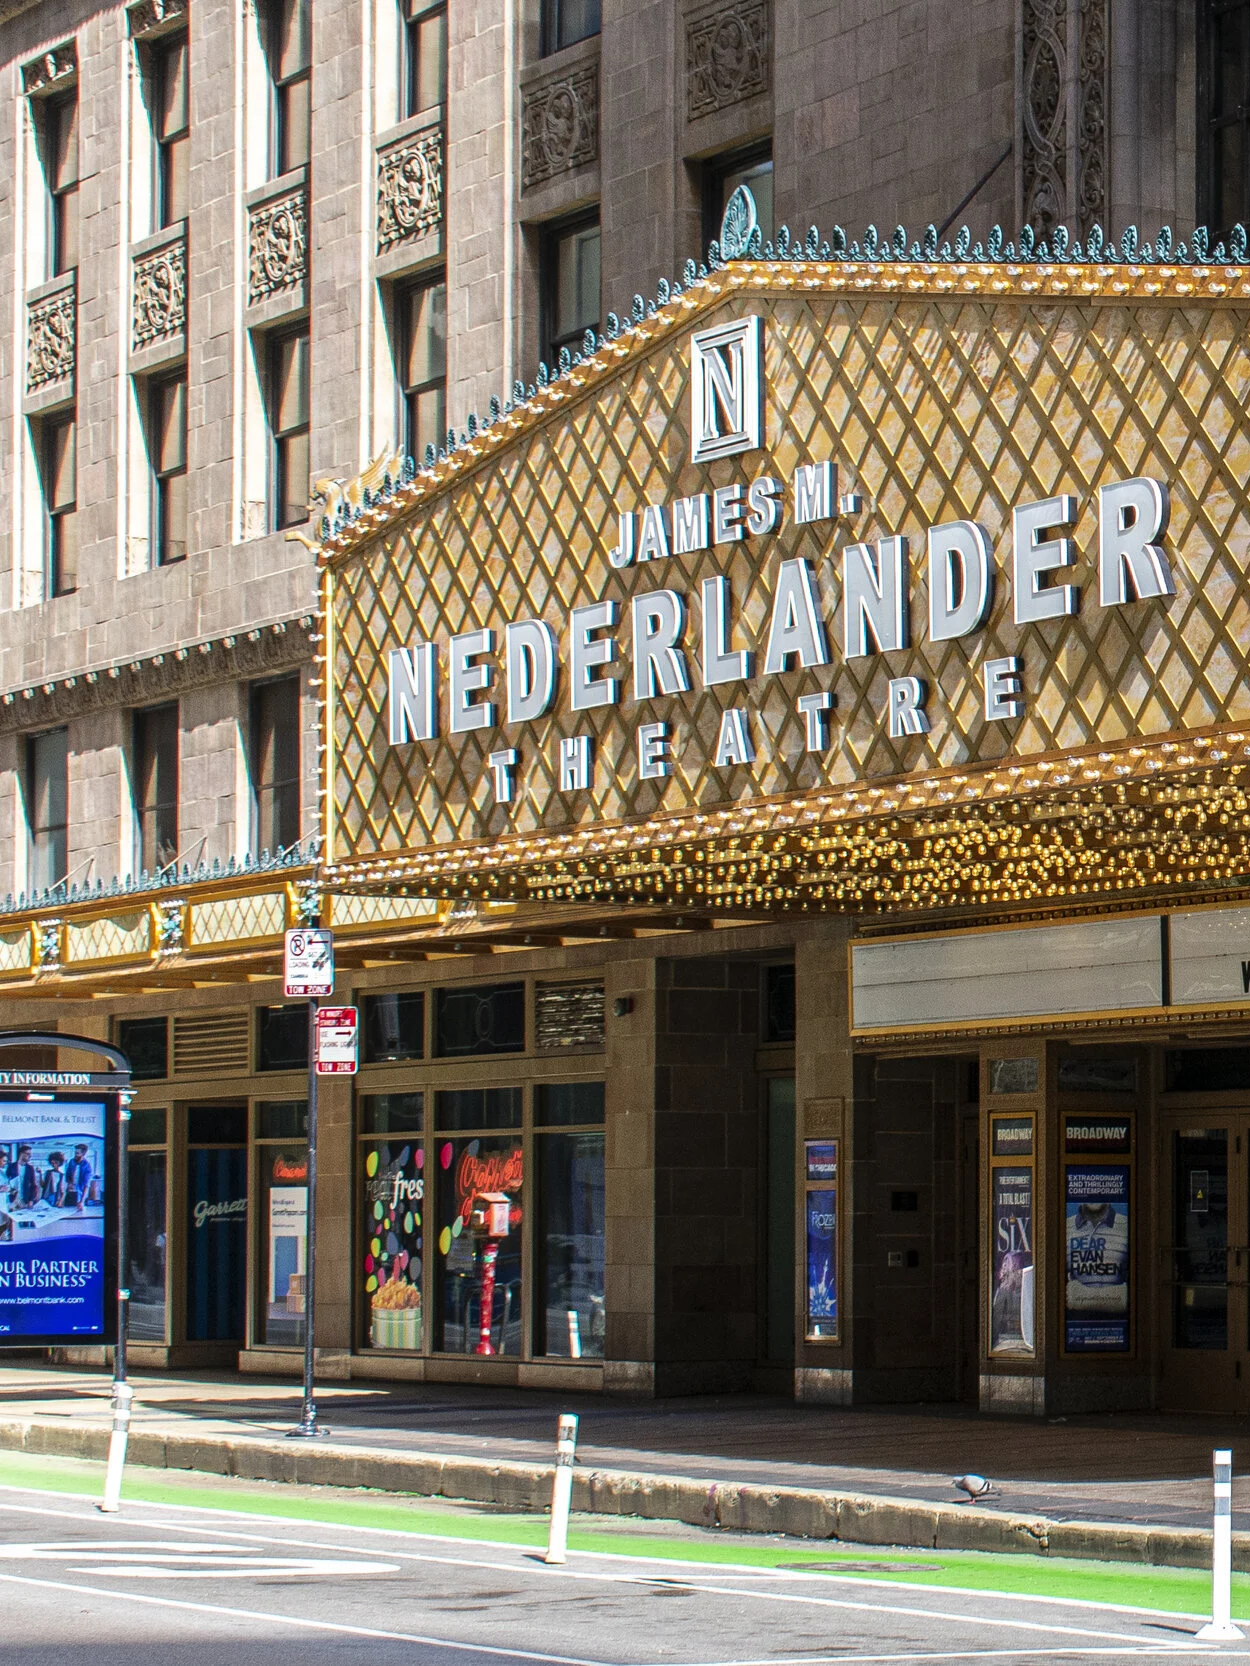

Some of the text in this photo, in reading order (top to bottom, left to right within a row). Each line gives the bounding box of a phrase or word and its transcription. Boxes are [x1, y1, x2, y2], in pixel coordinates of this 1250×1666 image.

[699, 344, 747, 440] N
[609, 459, 863, 569] JAMES M.
[388, 475, 1177, 746] NEDERLANDER
[488, 655, 1026, 803] THEATRE
[288, 985, 328, 994] TOW ZONE
[337, 1063, 352, 1071] ZONE
[14, 1073, 91, 1085] INFORMATION
[2, 1115, 97, 1123] BELMONT BANK & TRUST
[997, 1128, 1033, 1140] BROADWAY
[1066, 1127, 1127, 1139] BROADWAY
[390, 1171, 424, 1210] fres
[1070, 1237, 1106, 1250] DEAR
[1070, 1250, 1104, 1263] EVAN
[31, 1259, 99, 1274] PARTNER
[1070, 1263, 1121, 1276] HANSEN
[15, 1273, 87, 1287] BUSINESS
